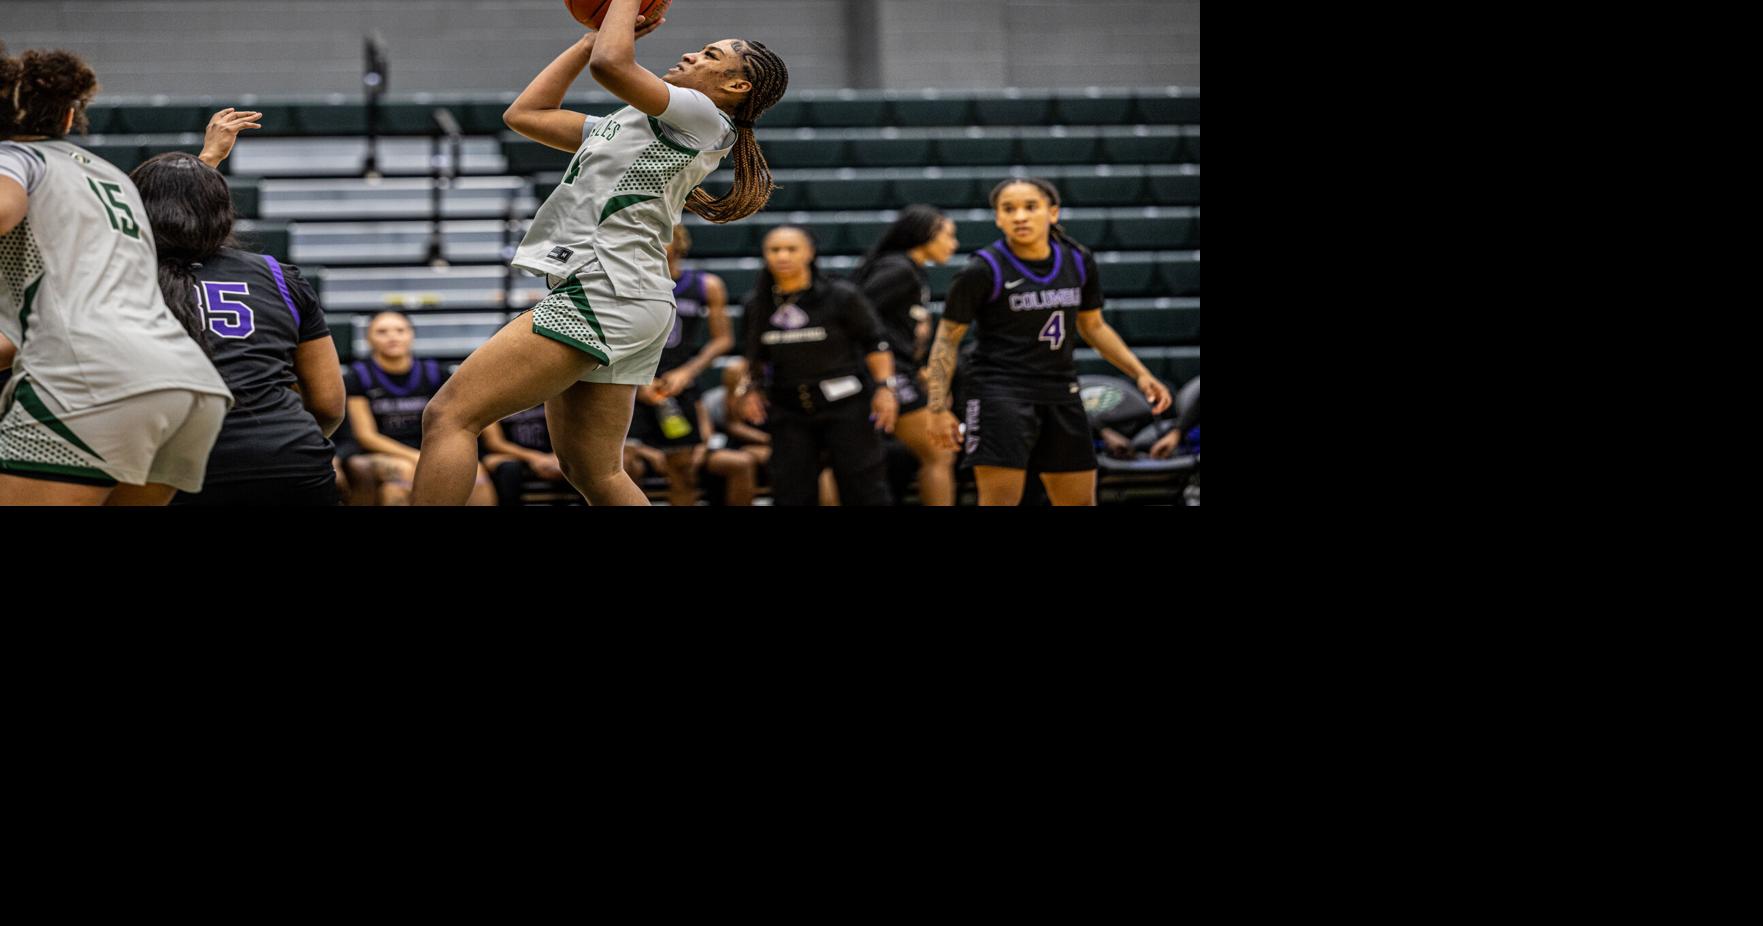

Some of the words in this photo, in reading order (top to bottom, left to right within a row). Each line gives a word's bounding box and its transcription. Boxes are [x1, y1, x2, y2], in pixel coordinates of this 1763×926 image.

[85, 175, 141, 240] 15
[193, 281, 255, 339] 5
[1038, 310, 1066, 351] 4
